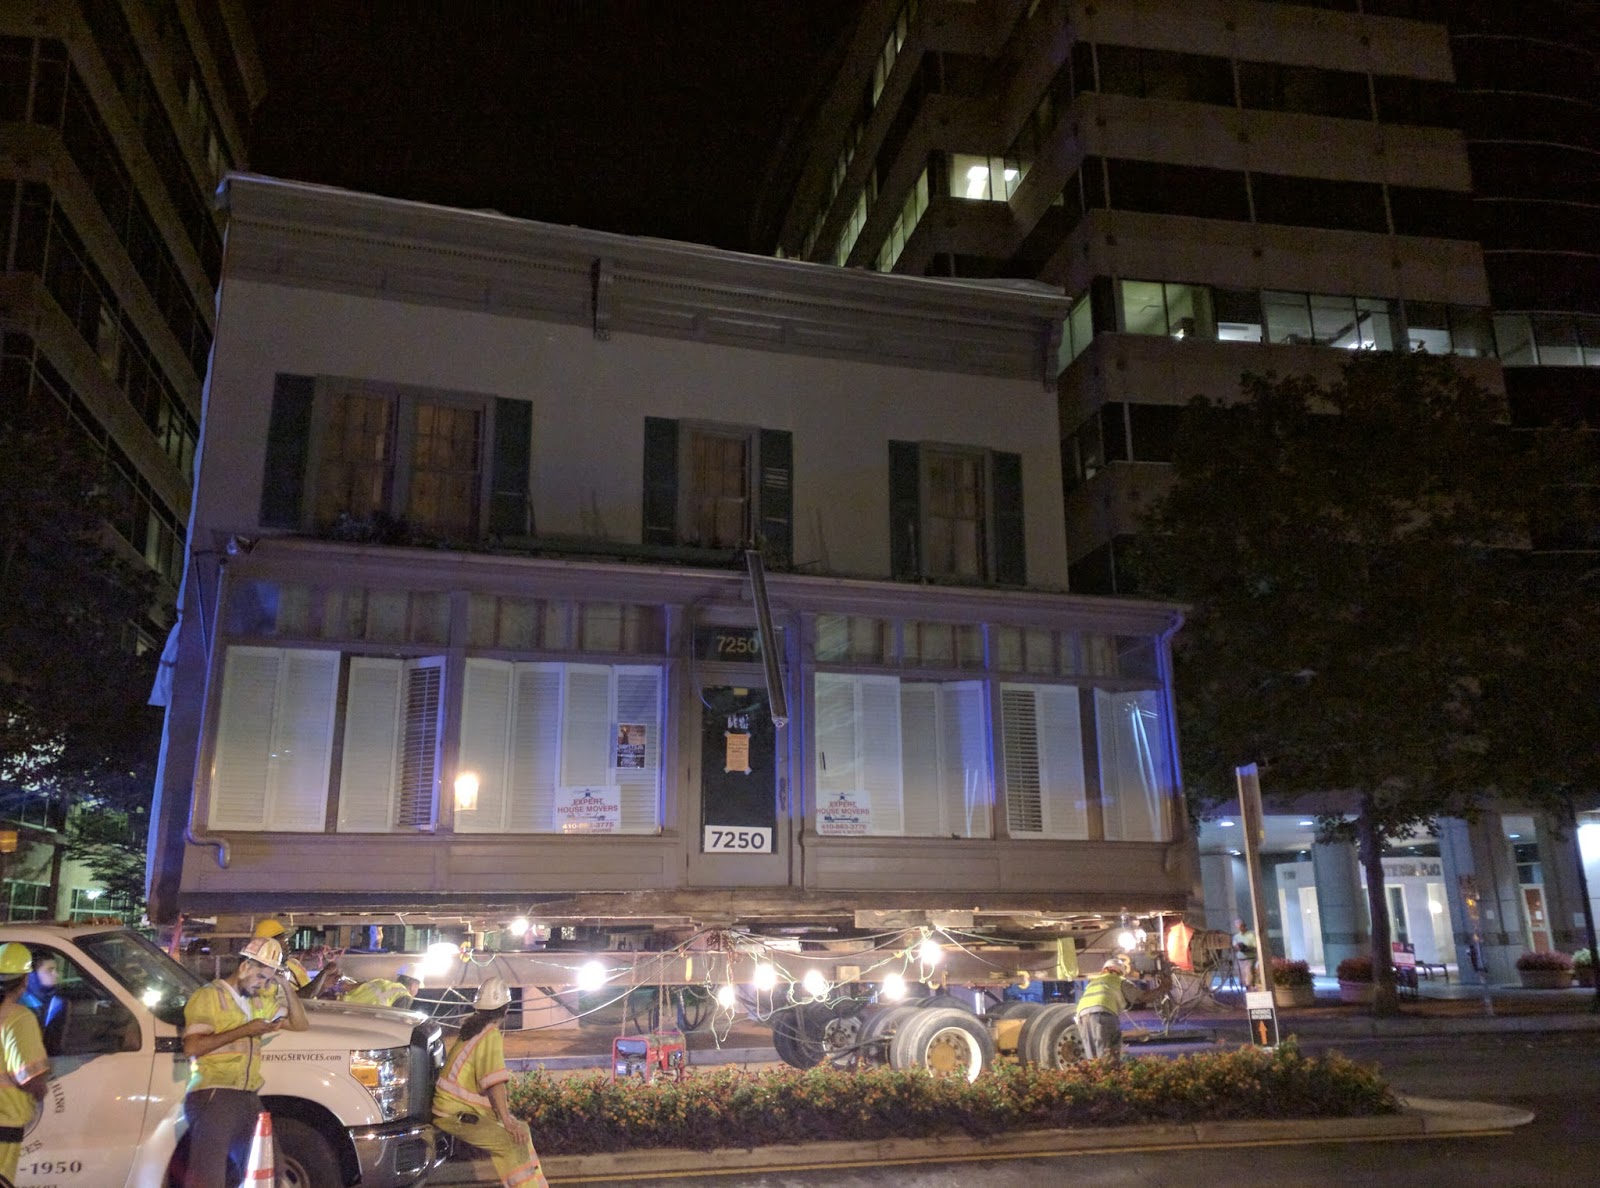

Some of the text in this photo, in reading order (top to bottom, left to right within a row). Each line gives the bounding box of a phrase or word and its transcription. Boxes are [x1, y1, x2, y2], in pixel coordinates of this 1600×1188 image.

[717, 636, 758, 653] 7250
[573, 798, 604, 806] EXPERT
[711, 831, 765, 849] 7250
